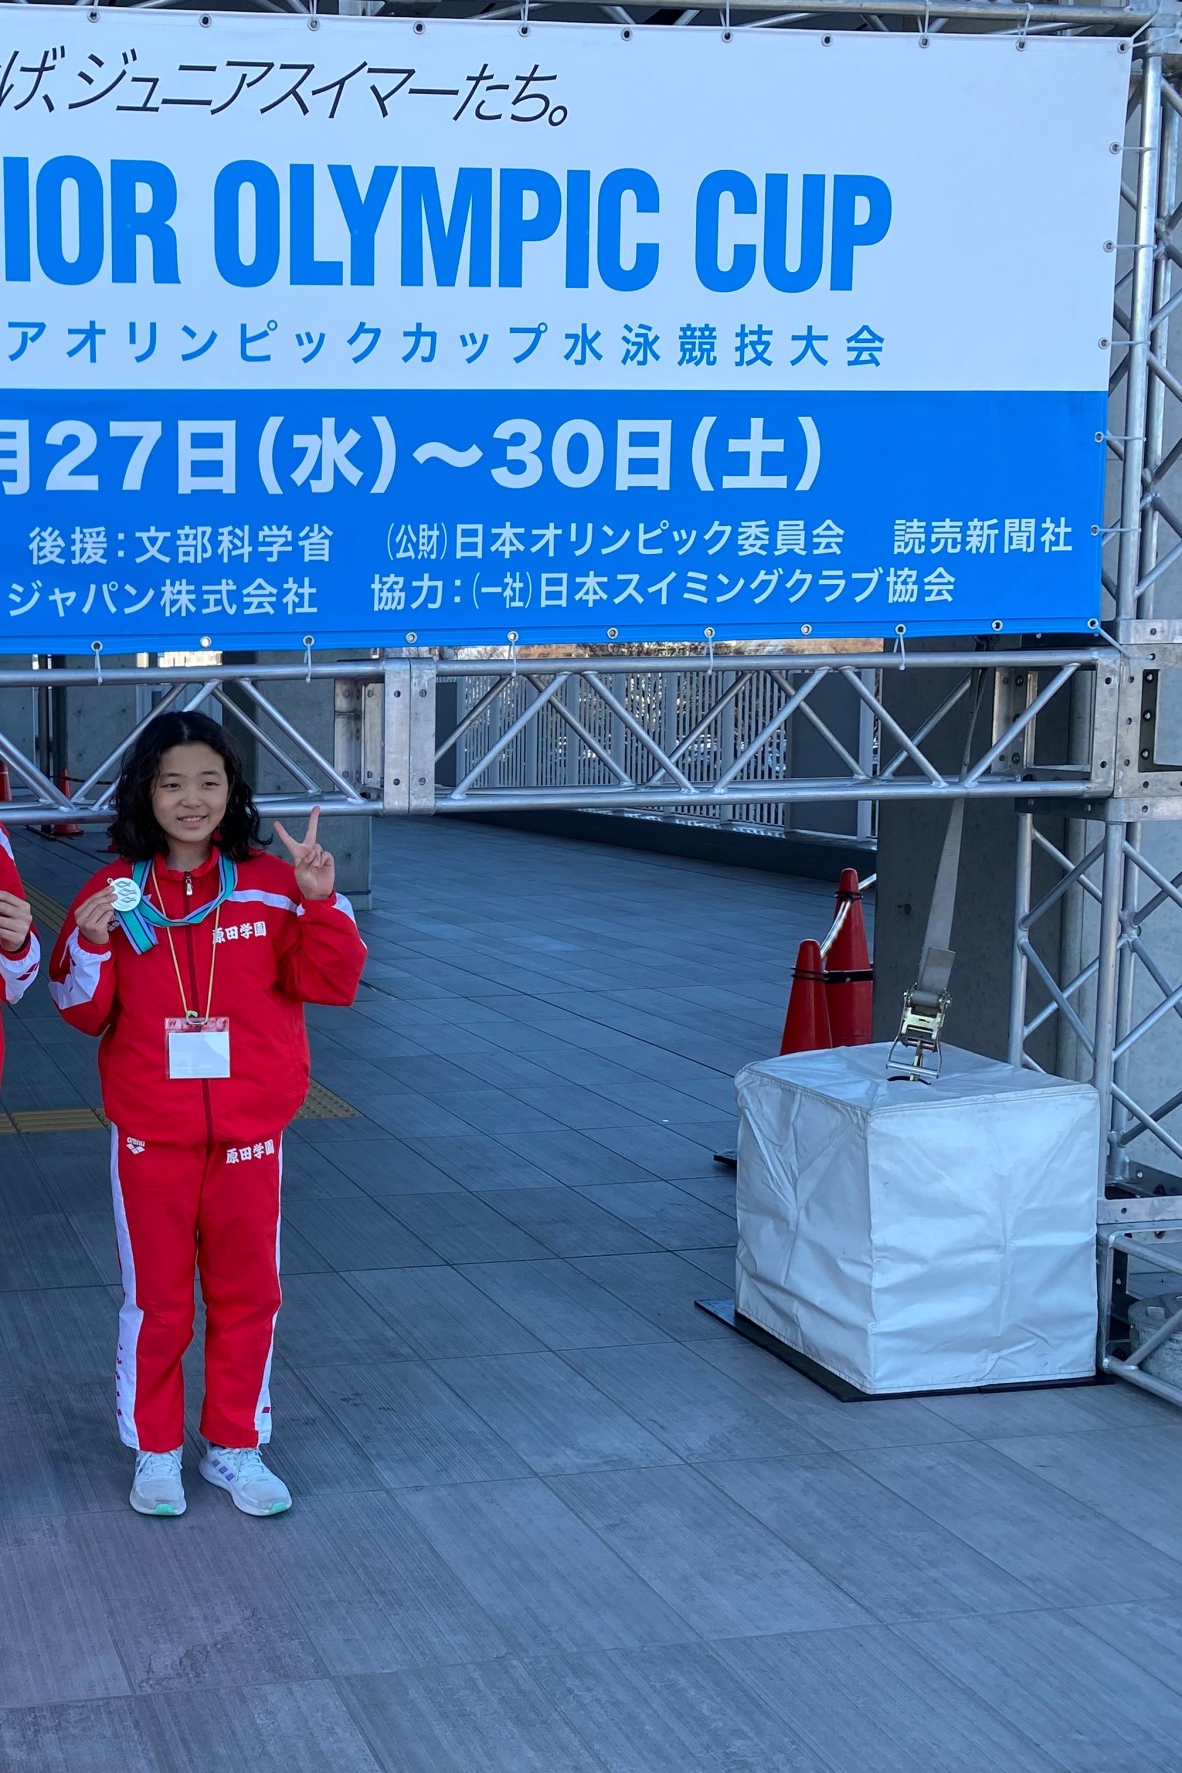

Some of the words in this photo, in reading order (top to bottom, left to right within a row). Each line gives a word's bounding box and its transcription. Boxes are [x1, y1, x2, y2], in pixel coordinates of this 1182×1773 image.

[213, 160, 660, 292] OLYMPIC
[695, 169, 893, 294] CUP
[893, 517, 1073, 554] 読売新聞社
[226, 1139, 275, 1164] 原田学園
